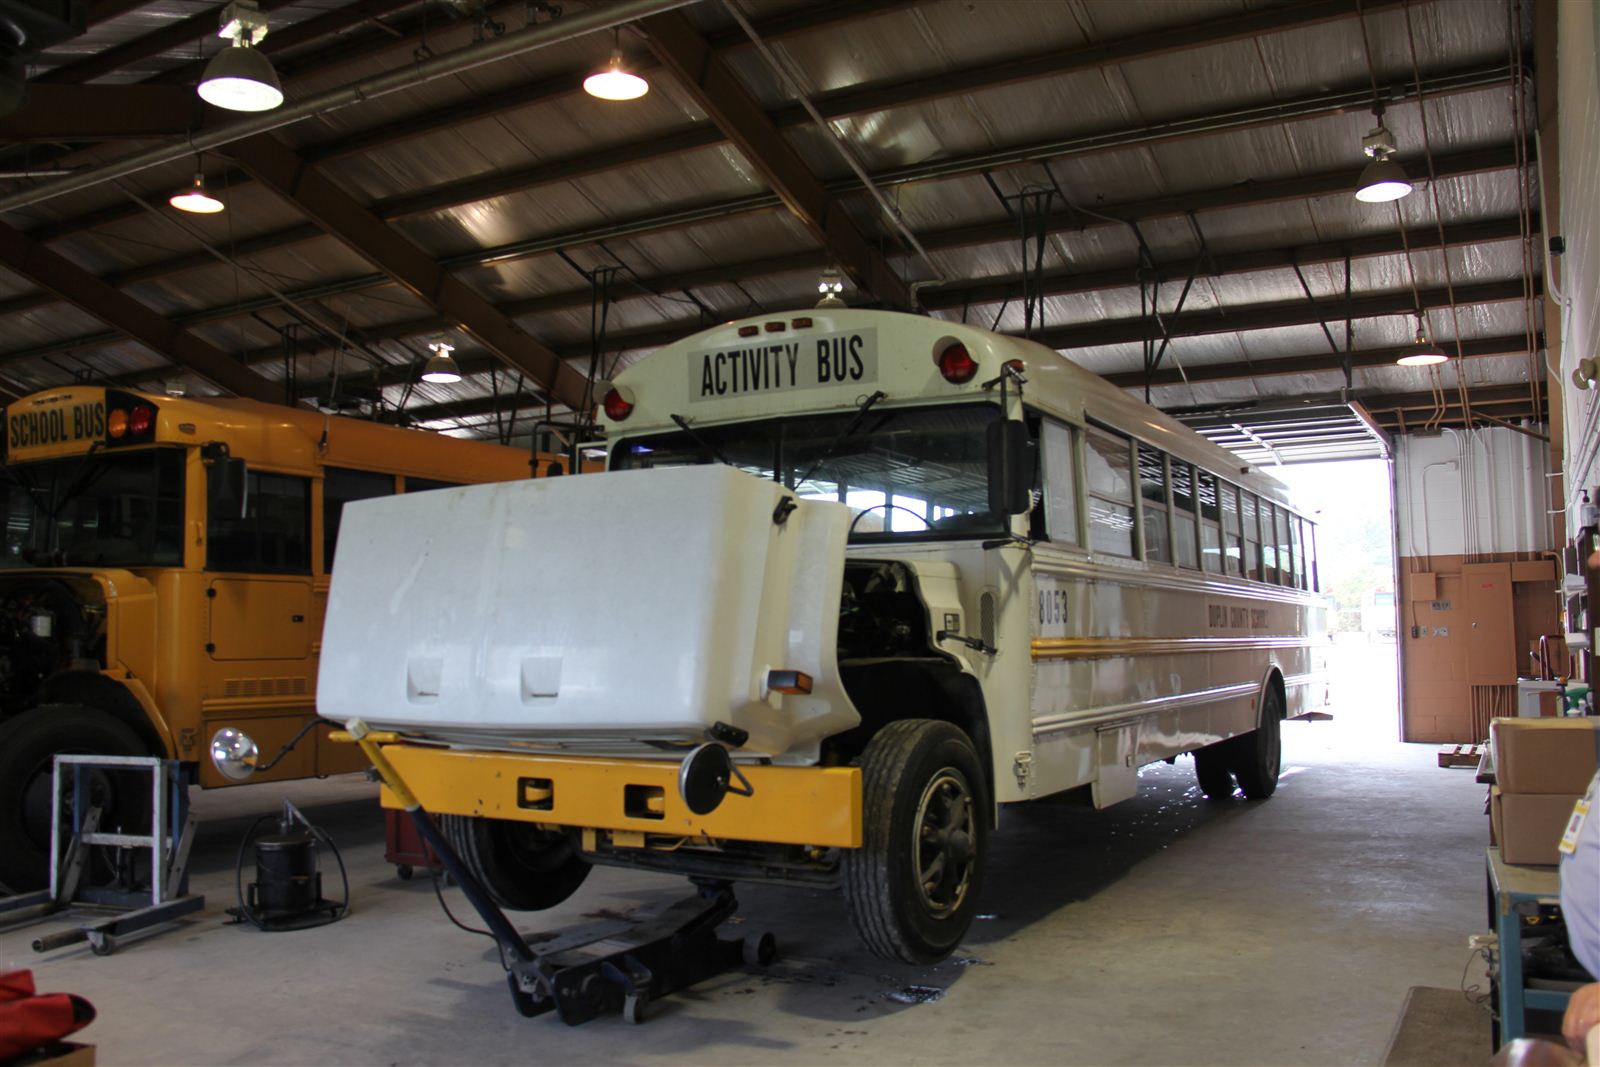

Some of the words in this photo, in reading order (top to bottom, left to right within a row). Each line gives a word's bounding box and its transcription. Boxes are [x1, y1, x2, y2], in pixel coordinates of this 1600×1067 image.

[701, 343, 799, 397] ACTIVITY
[817, 334, 864, 383] BUS
[10, 408, 69, 448] SCHOOL
[73, 402, 105, 440] BUS
[1039, 590, 1068, 624] 8053
